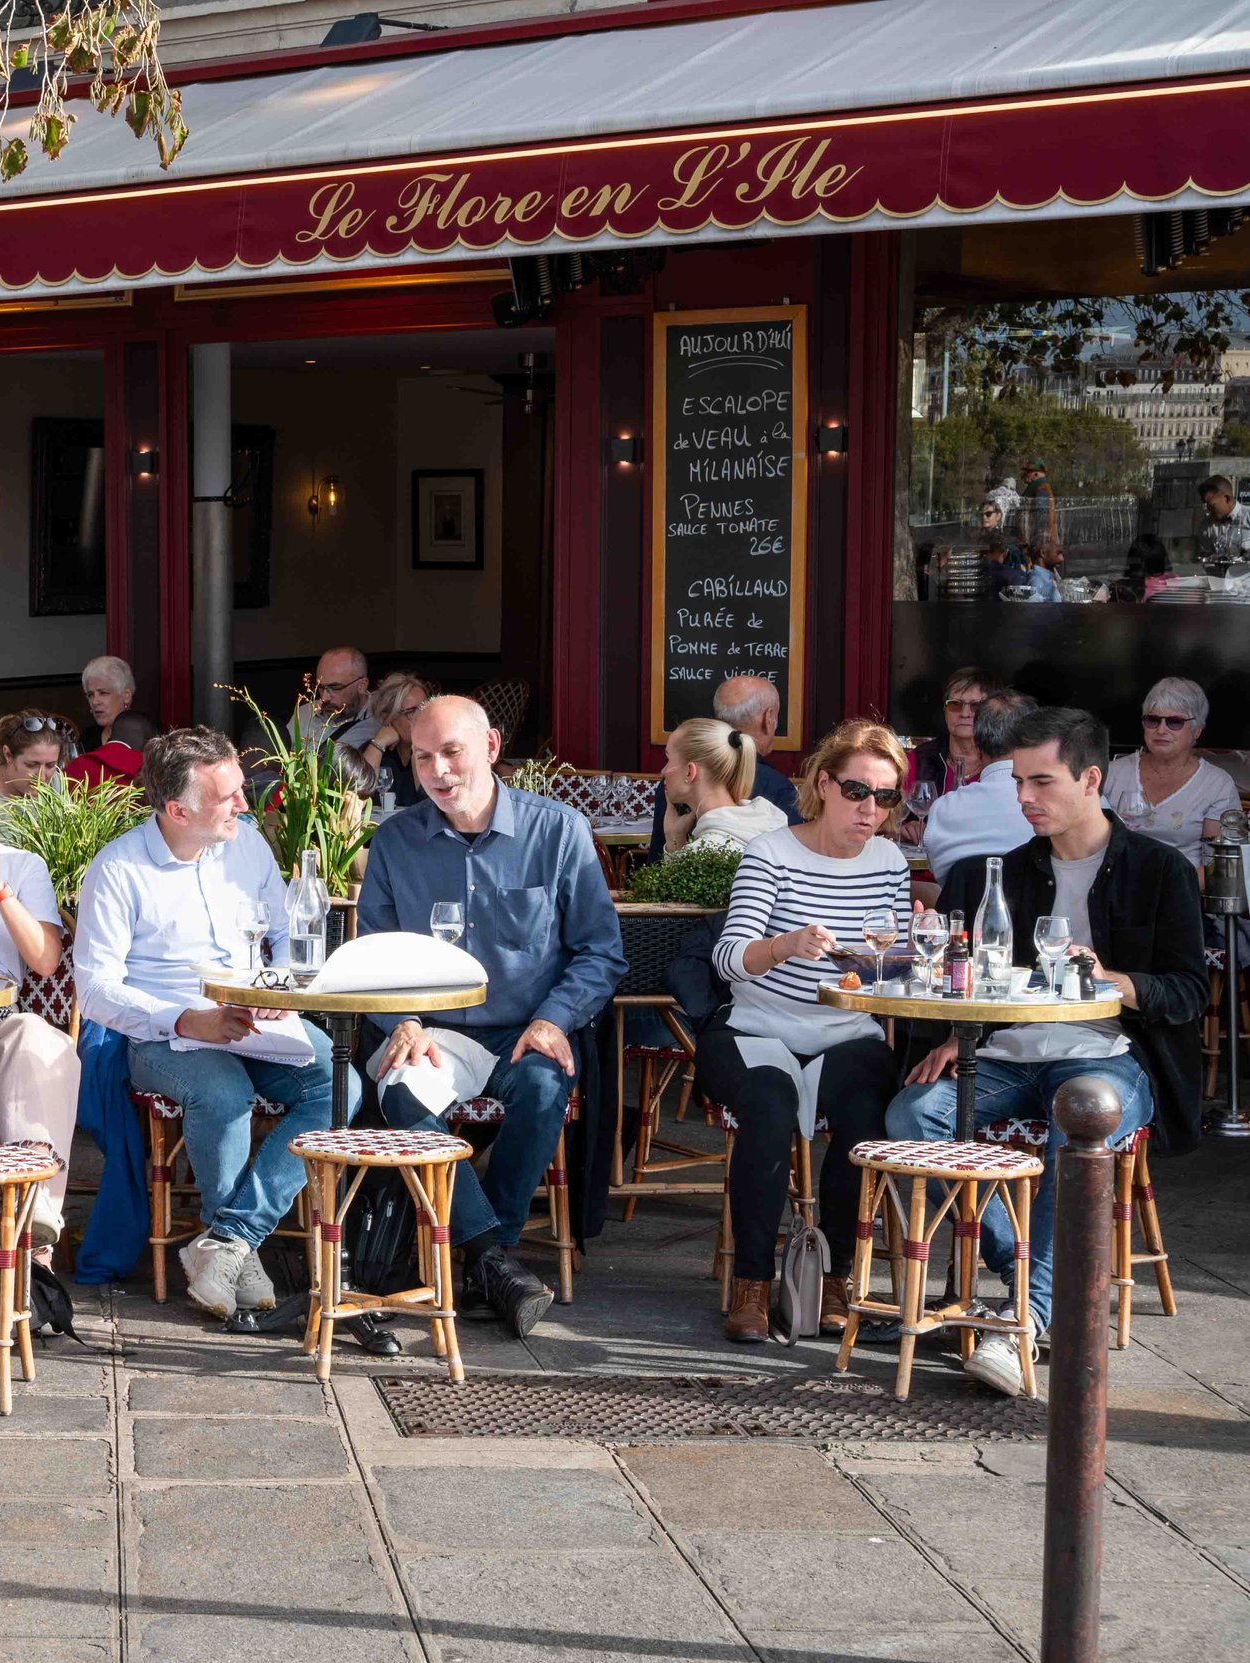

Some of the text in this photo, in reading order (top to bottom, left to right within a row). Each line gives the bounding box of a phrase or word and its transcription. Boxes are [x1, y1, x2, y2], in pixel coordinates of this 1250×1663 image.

[295, 181, 376, 244] Le
[386, 173, 554, 234] Flore
[561, 183, 651, 217] en
[682, 389, 791, 416] ESCALOPE
[673, 433, 690, 450] de
[692, 425, 752, 450] VEAU
[772, 421, 791, 439] la
[680, 493, 754, 520] PENNES
[668, 519, 780, 538] SAUCE TOMATE
[750, 536, 786, 556] 26€
[677, 607, 764, 628] PURÉE de
[669, 635, 788, 658] POMME de TERRE
[669, 667, 714, 680] SAUCE
